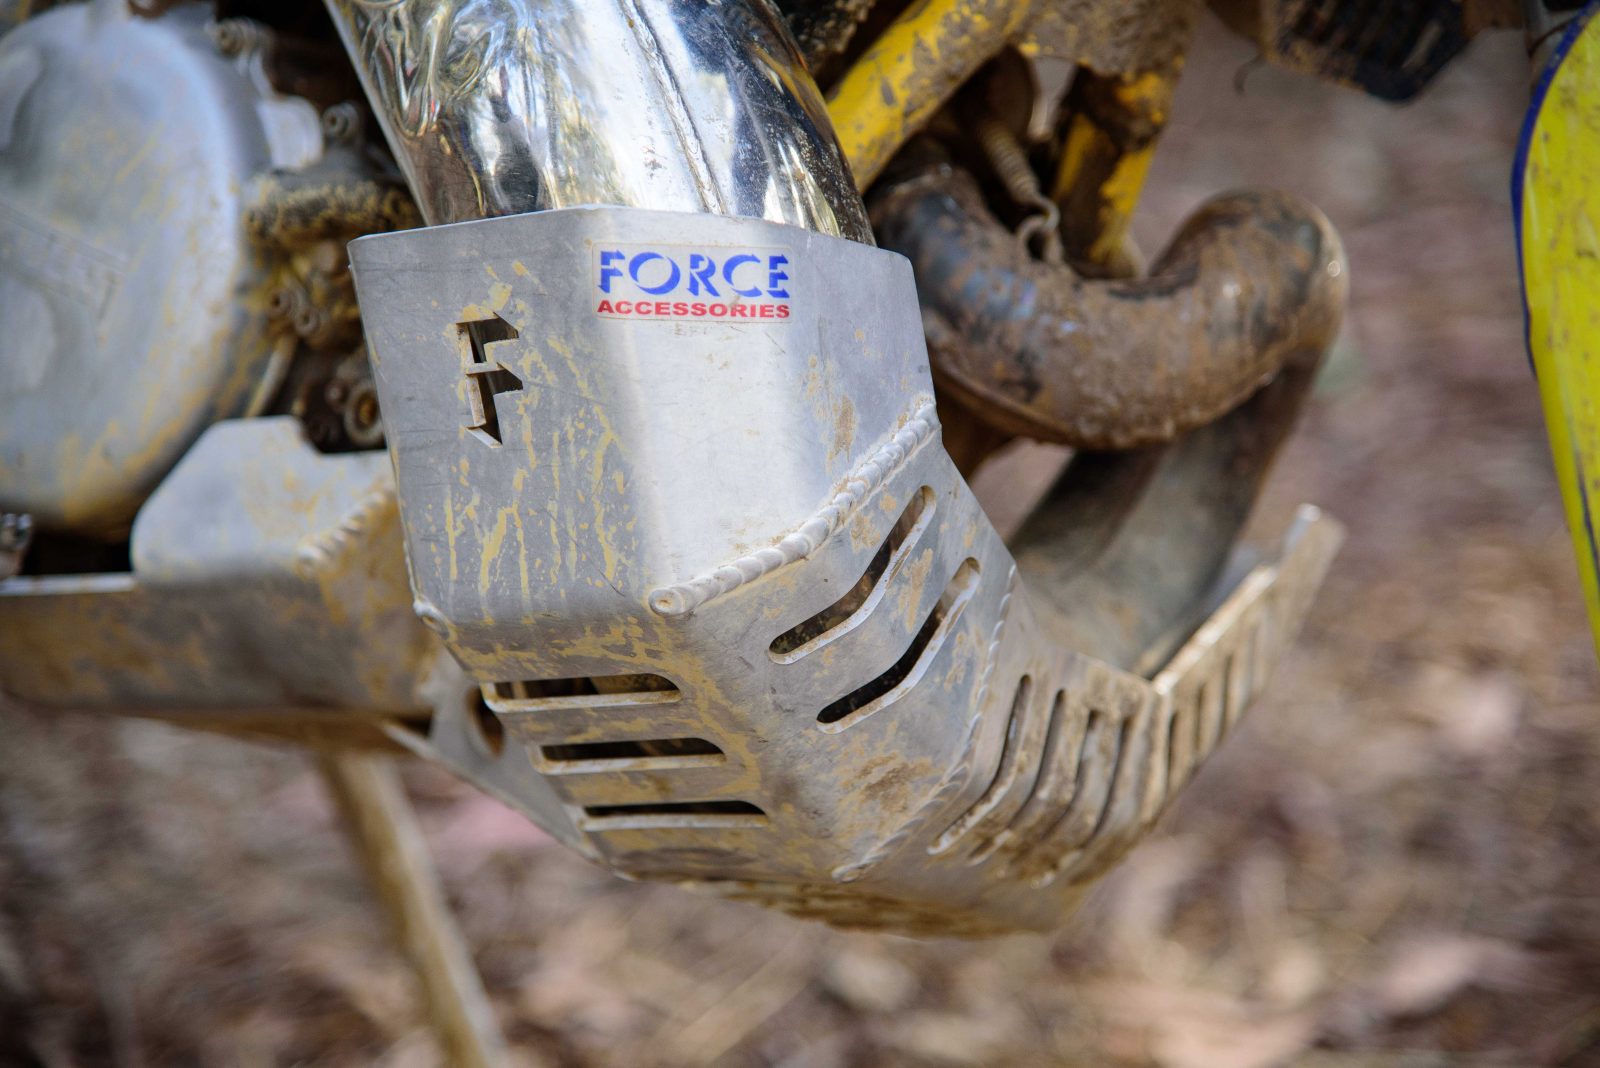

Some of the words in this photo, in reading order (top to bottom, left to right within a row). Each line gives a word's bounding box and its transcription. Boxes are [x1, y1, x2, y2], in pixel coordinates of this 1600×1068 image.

[598, 249, 790, 298] FORCE
[597, 300, 790, 319] ACCESSORIES
[455, 311, 524, 449] F
